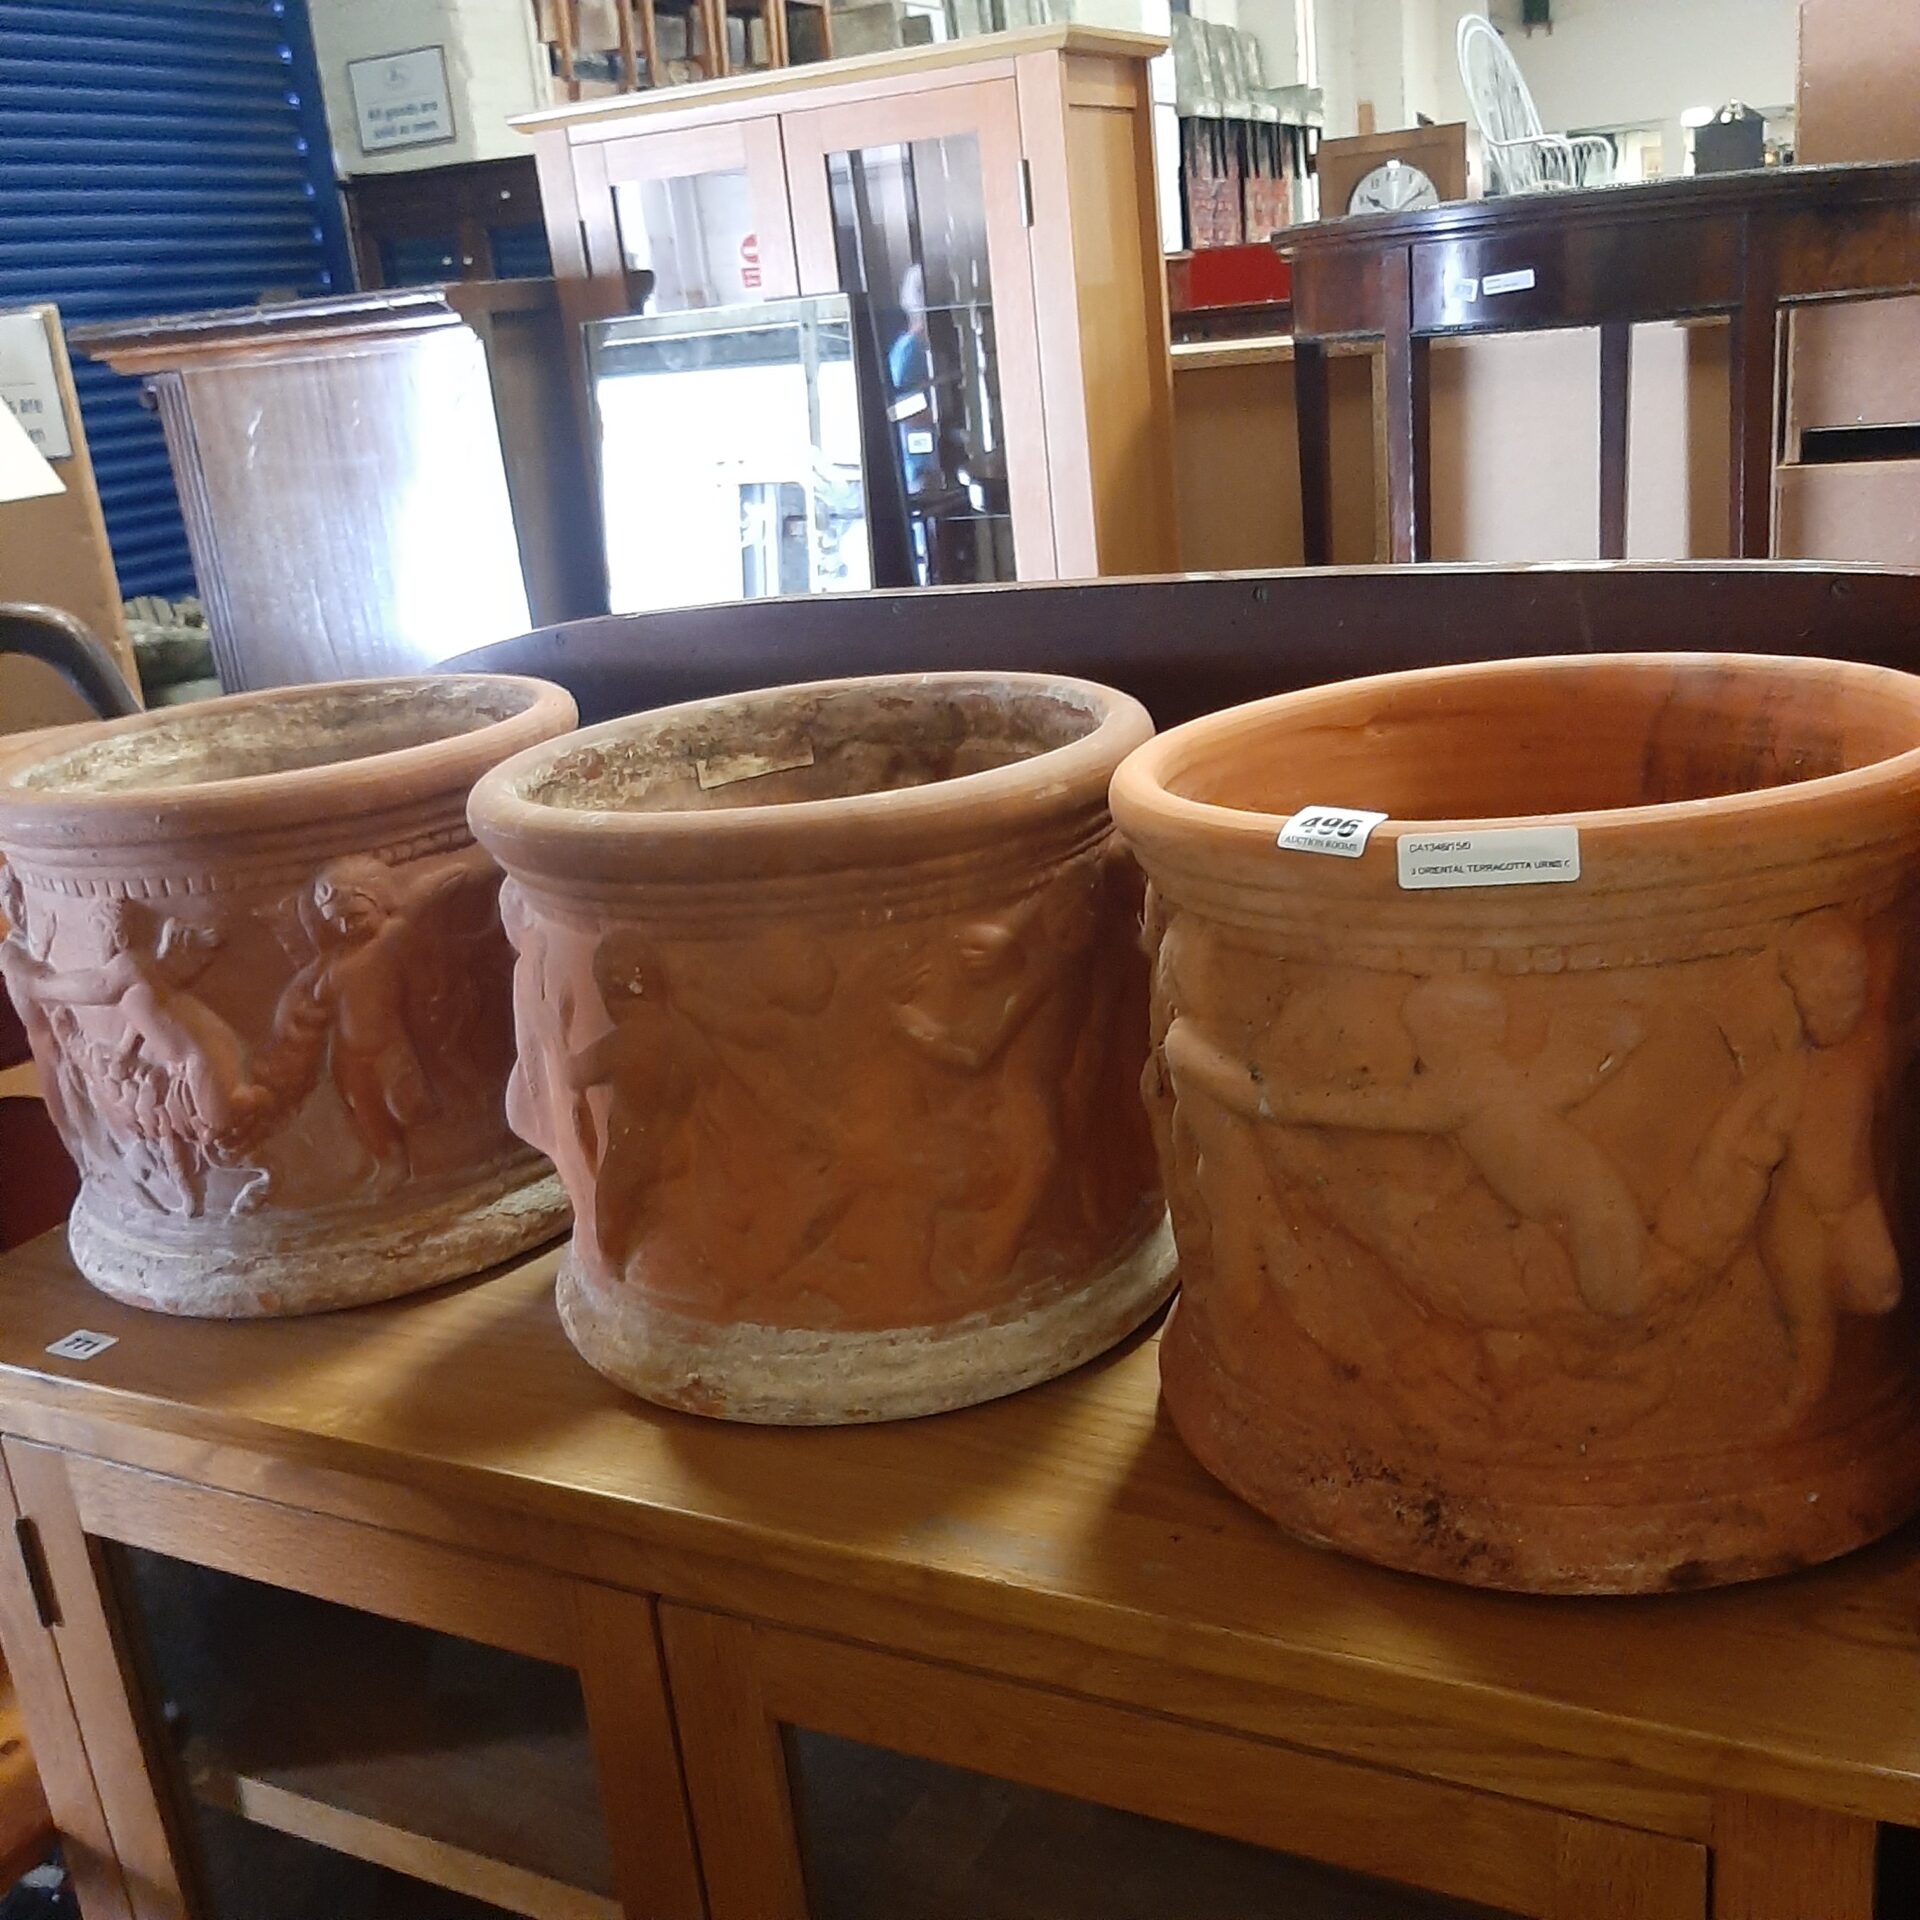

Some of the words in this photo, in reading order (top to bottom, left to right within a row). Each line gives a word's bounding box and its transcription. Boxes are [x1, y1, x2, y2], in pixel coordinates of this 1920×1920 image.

[1299, 816, 1364, 838] 496
[1283, 835, 1324, 848] AUCTION
[1325, 839, 1358, 852] ROOMS
[1418, 865, 1464, 875] ORIENTAL
[1467, 862, 1532, 873] TERRACOTTA
